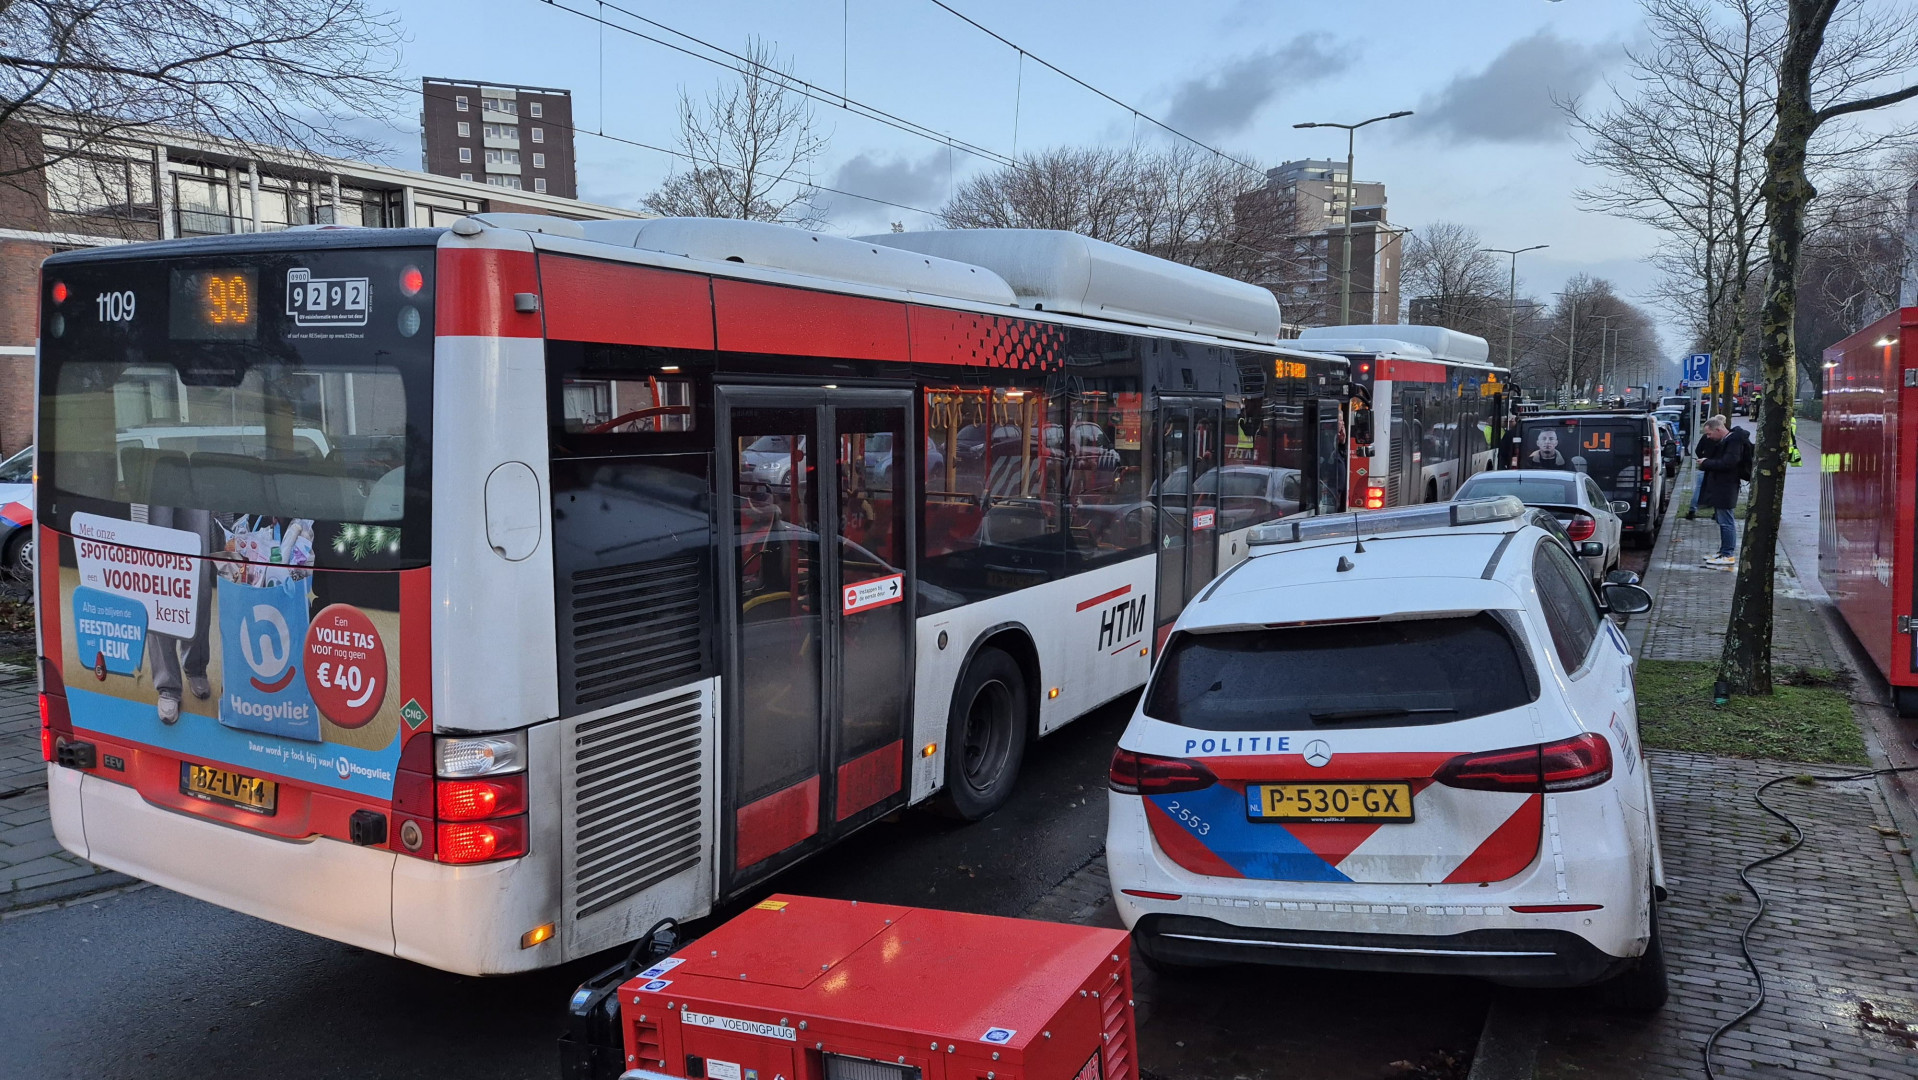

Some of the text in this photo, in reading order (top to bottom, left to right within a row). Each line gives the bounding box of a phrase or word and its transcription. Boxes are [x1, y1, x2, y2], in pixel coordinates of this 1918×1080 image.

[96, 290, 136, 322] 1109
[209, 276, 249, 323] 99
[293, 286, 361, 307] 9292
[1693, 356, 1706, 371] P
[79, 523, 116, 541] Met onze
[80, 542, 193, 572] SPOTGOEDKOOPJES
[87, 568, 192, 600] een VOORDELIGE
[155, 600, 191, 625] kerst
[334, 616, 348, 627] Een
[1098, 594, 1147, 652] HTM
[79, 618, 141, 641] FEESTDAGEN
[315, 627, 375, 650] VOLLE TAS
[100, 638, 130, 661] LEUK
[311, 644, 366, 661] voor nog geen
[316, 662, 362, 692] € 40
[231, 693, 309, 721] Hoogvliet
[405, 708, 422, 721] CNG
[248, 740, 264, 753] Daar
[265, 745, 281, 757] word
[283, 748, 289, 763] je
[291, 748, 305, 762] toch
[306, 751, 317, 770] blij
[1185, 736, 1290, 754] POLITIE
[104, 755, 123, 770] EEV
[350, 763, 392, 781] Hoogvliet
[197, 766, 265, 803] BZ-LV-14
[1250, 788, 1400, 813] NL P-530-GX
[1168, 800, 1211, 836] 2553
[681, 1012, 796, 1040] LET OP VOEDINGPLUG!
